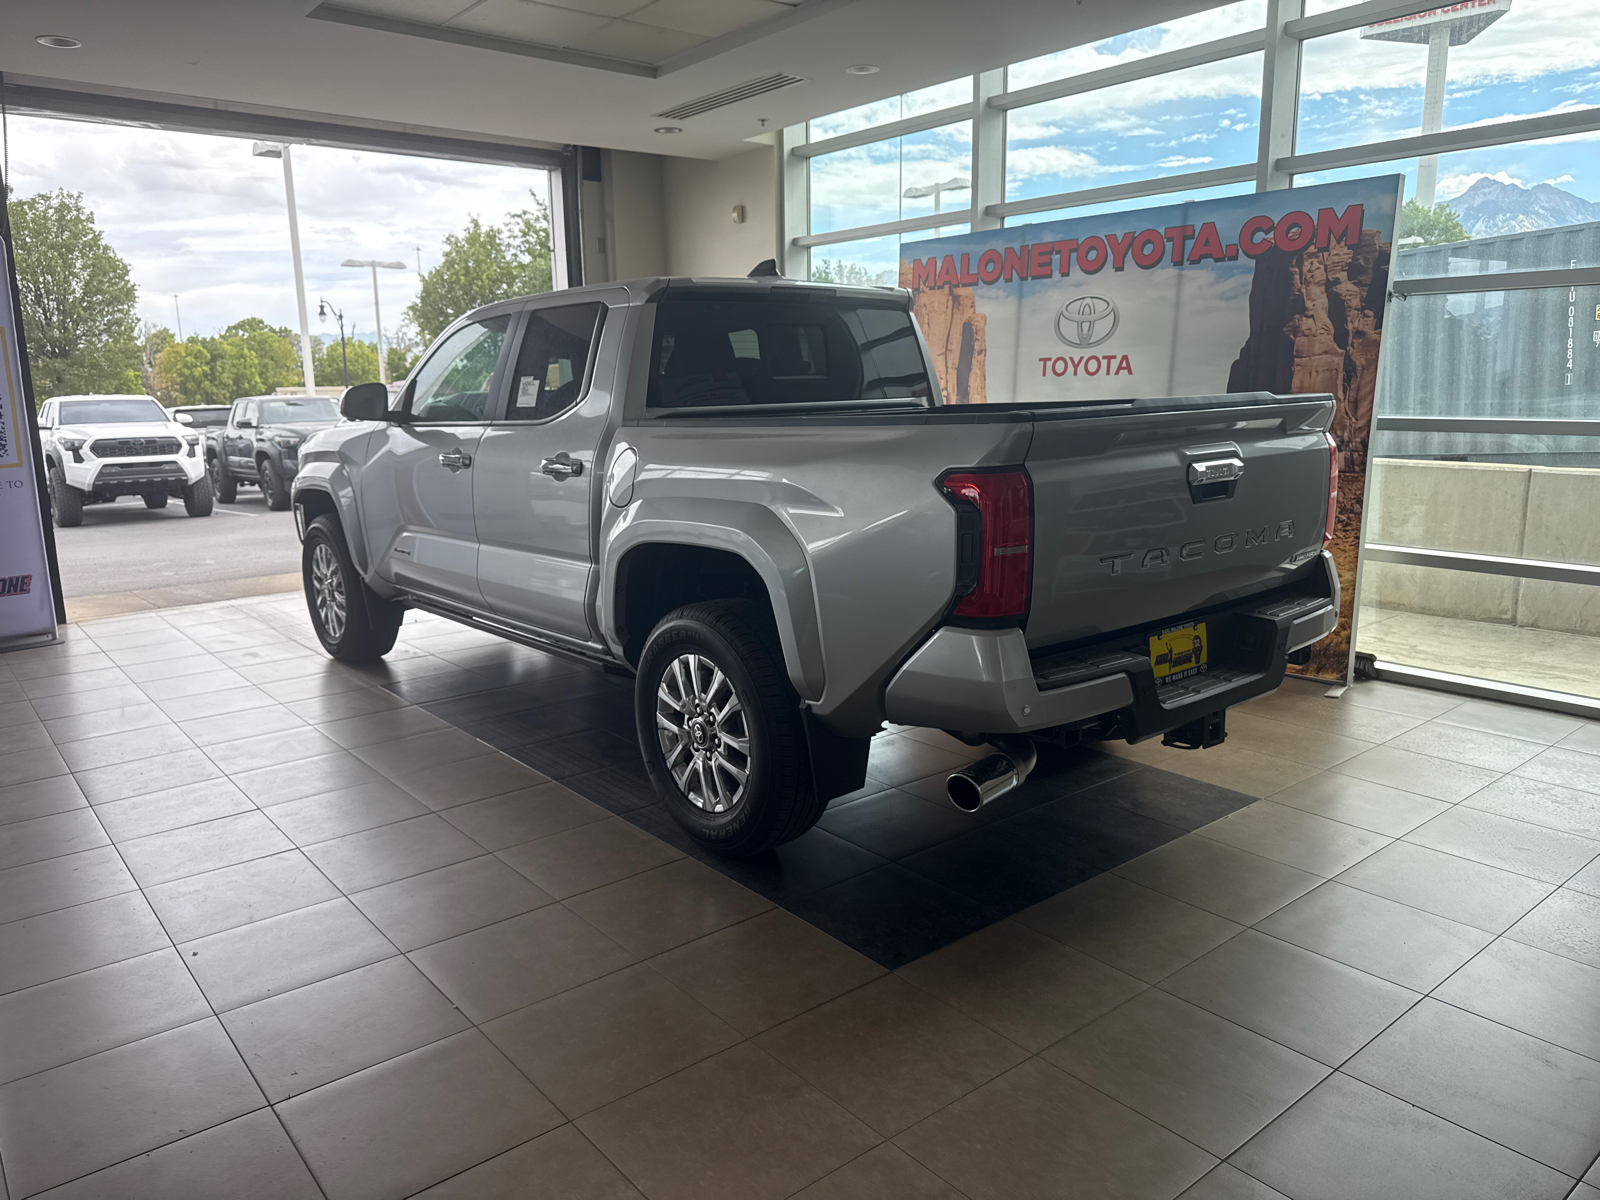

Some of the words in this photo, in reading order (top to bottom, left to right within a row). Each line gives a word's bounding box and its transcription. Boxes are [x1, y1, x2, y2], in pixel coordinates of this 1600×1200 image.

[912, 203, 1365, 289] MALONETOYOTA.COM
[1038, 354, 1134, 378] TOYOTA
[6, 479, 24, 489] TO
[1100, 519, 1296, 576] TACOMA
[1193, 638, 1201, 647] 32
[1165, 675, 1172, 683] WE
[1172, 672, 1183, 681] MAKE
[1188, 668, 1198, 676] EASY
[702, 804, 751, 840] GENERAL
